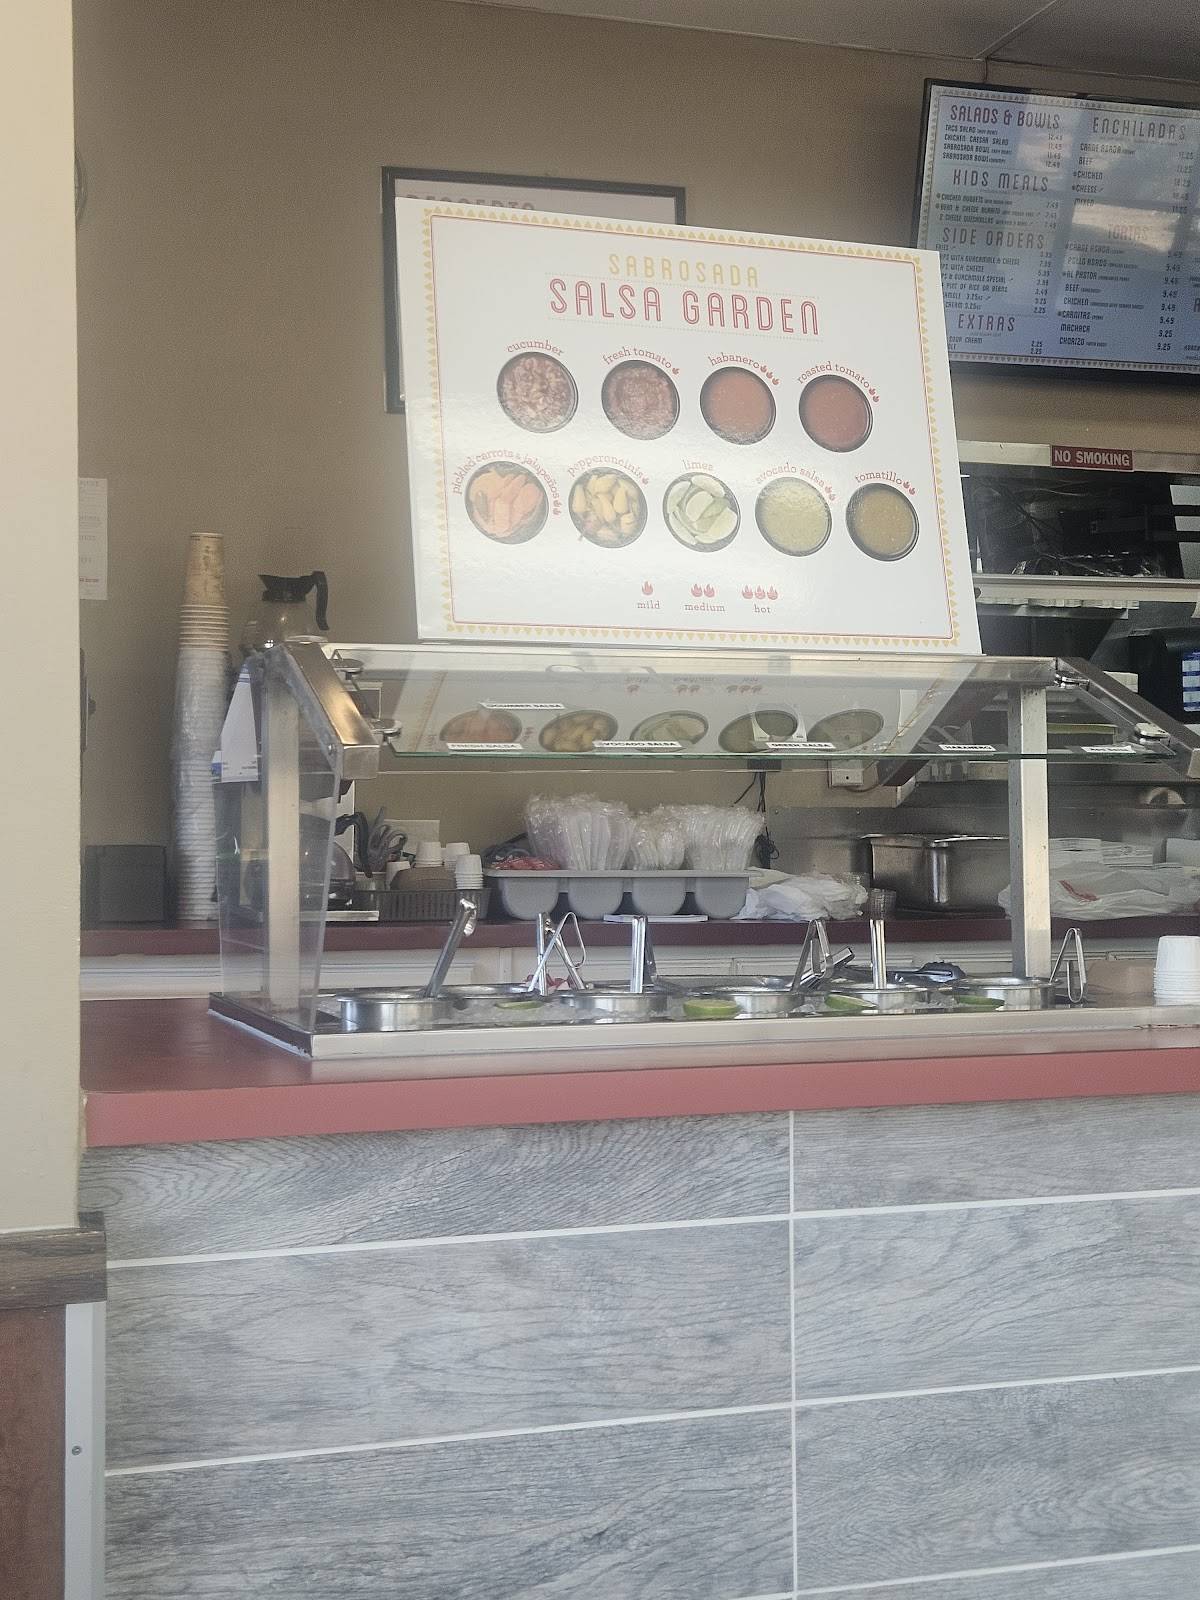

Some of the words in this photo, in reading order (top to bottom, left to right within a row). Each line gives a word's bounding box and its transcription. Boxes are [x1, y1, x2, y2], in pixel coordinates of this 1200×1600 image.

[950, 104, 999, 124] SALADS
[1004, 110, 1012, 125] &
[1017, 110, 1060, 129] BOWLS
[1092, 117, 1186, 140] ENCHILADAS
[953, 169, 989, 187] KIDS
[998, 173, 1049, 192] MEALS
[1077, 170, 1103, 180] CHICKEN
[1075, 184, 1097, 194] CHEESE
[942, 228, 977, 245] SIDE
[986, 230, 1045, 249] ORDERS
[609, 254, 758, 288] SABROSADA
[1075, 270, 1098, 280] PASTOR
[1065, 283, 1080, 292] BEEF
[550, 278, 661, 321] SALSA
[682, 291, 819, 335] GARDEN
[1063, 296, 1089, 306] CHICKEN
[958, 314, 1016, 332] EXTRAS
[1060, 323, 1091, 333] MACHACA
[507, 340, 564, 357] cucumber
[1059, 336, 1085, 346] CHORIZO
[602, 346, 631, 365] fresh
[633, 348, 672, 369] tomato
[708, 353, 760, 369] habanero
[797, 362, 833, 385] roasted
[835, 363, 870, 389] tomato
[682, 459, 714, 471] limes
[1054, 450, 1071, 463] NO
[1075, 451, 1130, 466] SMOKING
[452, 457, 476, 495] pickled
[475, 449, 514, 462] carrots
[755, 462, 797, 484] avocado
[799, 468, 825, 487] salsa
[855, 471, 902, 485] tomatillo
[637, 600, 661, 610] mild
[684, 602, 726, 613] medium
[753, 604, 772, 614] hot
